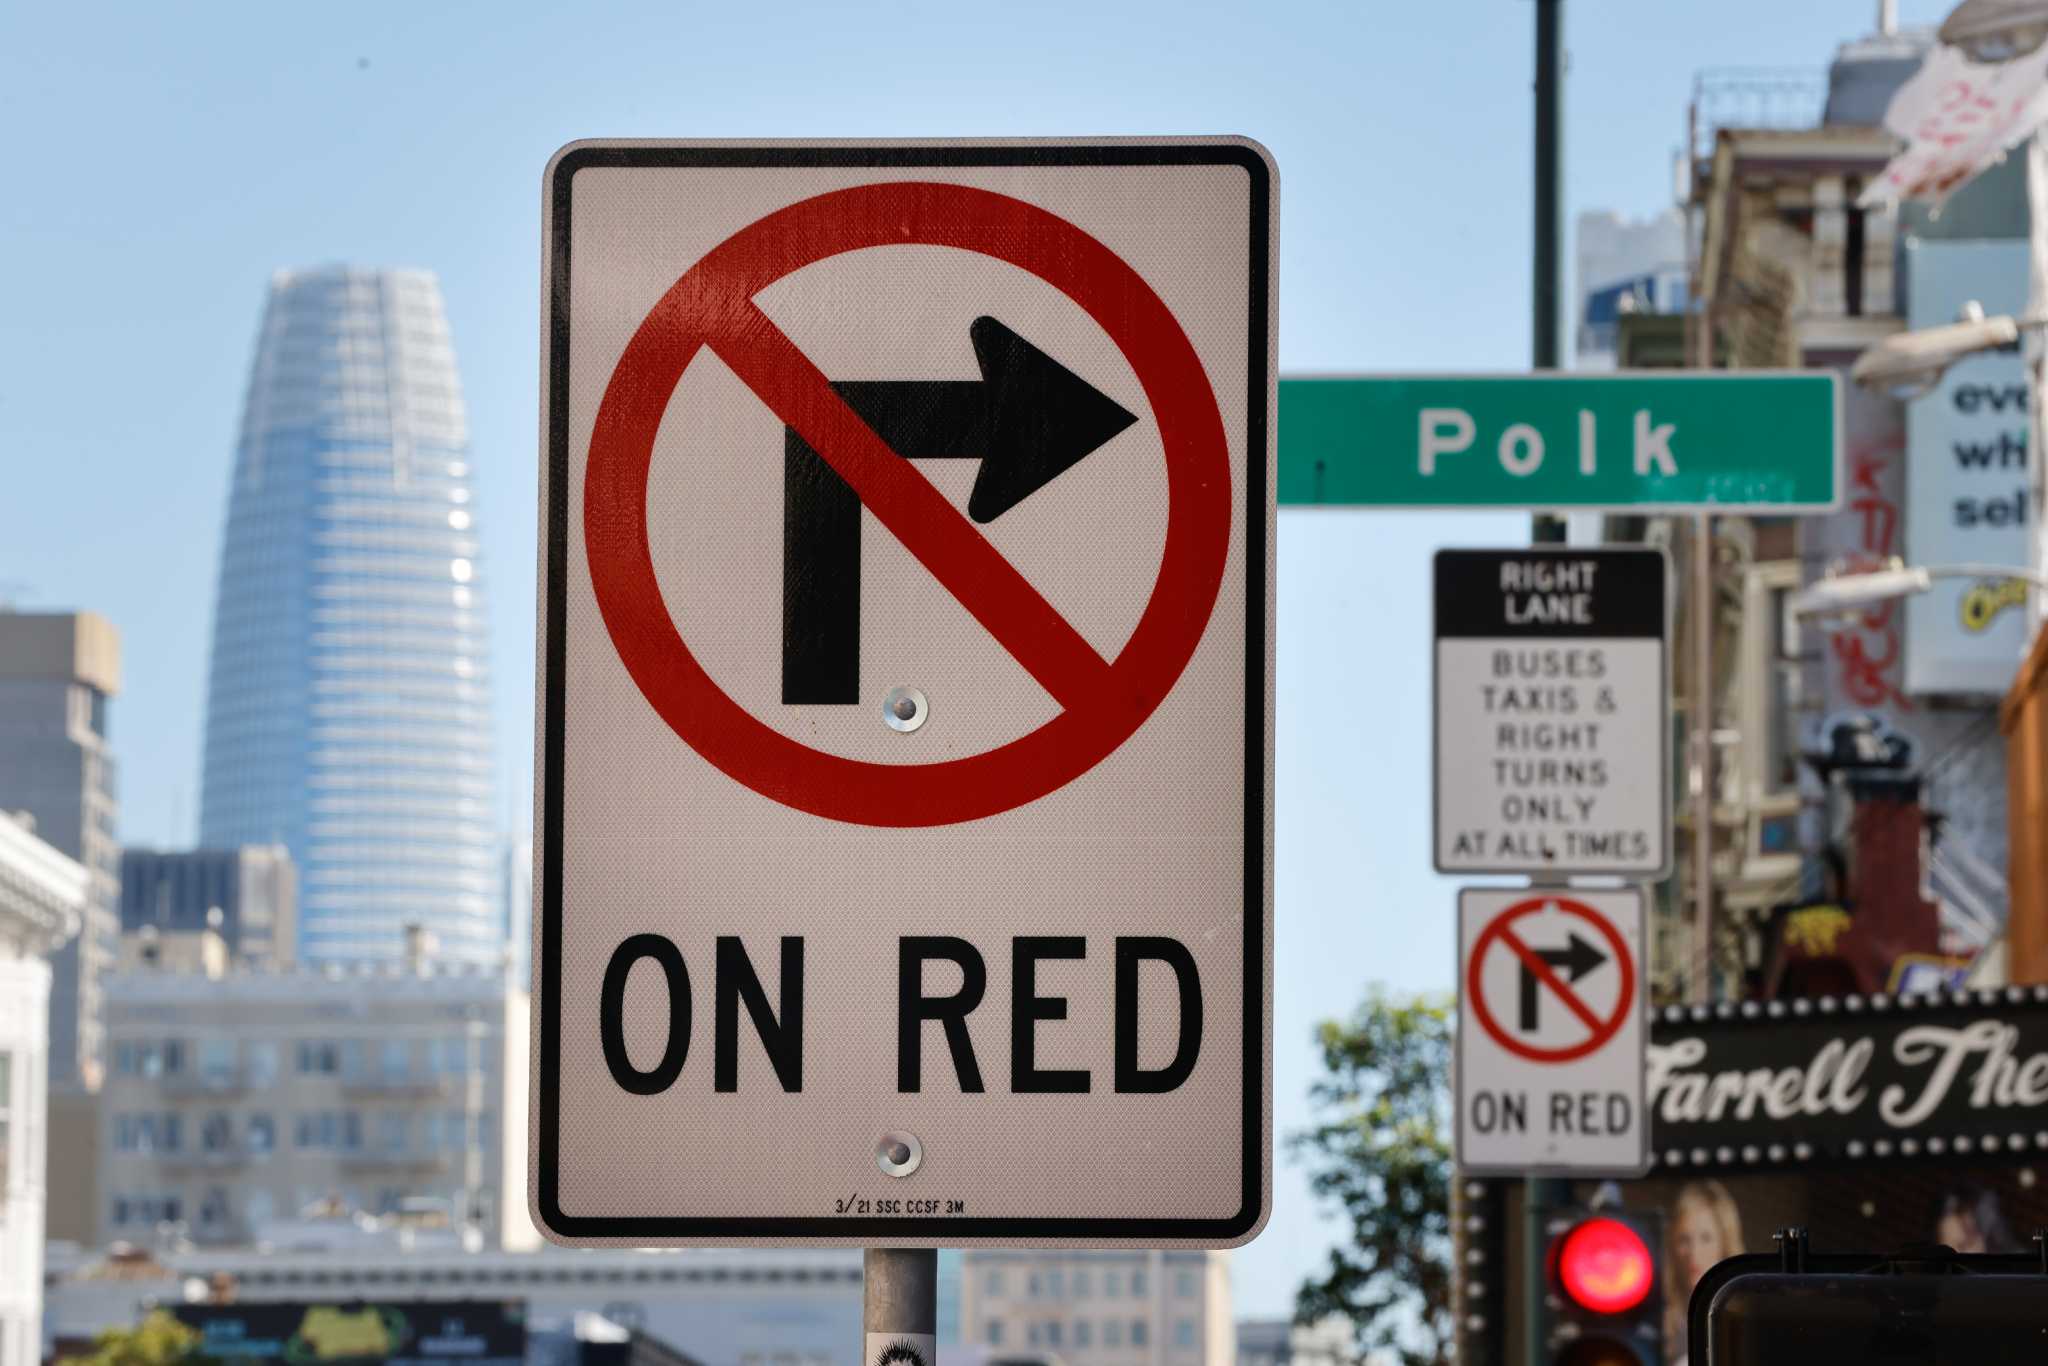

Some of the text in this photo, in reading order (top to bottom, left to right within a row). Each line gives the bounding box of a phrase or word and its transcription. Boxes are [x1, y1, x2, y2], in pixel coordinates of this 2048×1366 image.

[1417, 408, 1679, 477] Polk
[1500, 561, 1598, 592] RIGHT
[1505, 594, 1593, 624] LANE
[1492, 650, 1607, 679] BUSES
[1482, 685, 1617, 714] TAXIS &
[1497, 723, 1600, 750] RIGHT
[1493, 760, 1607, 787] TURNS
[1502, 796, 1596, 823] ONLY
[1453, 831, 1649, 859] AT ALL TIMES
[600, 934, 1203, 1095] ON RED
[1646, 1037, 1875, 1123] Farrell
[1472, 1091, 1631, 1135] ON RED
[835, 1193, 964, 1213] 3/21 SSC CCSF 3M
